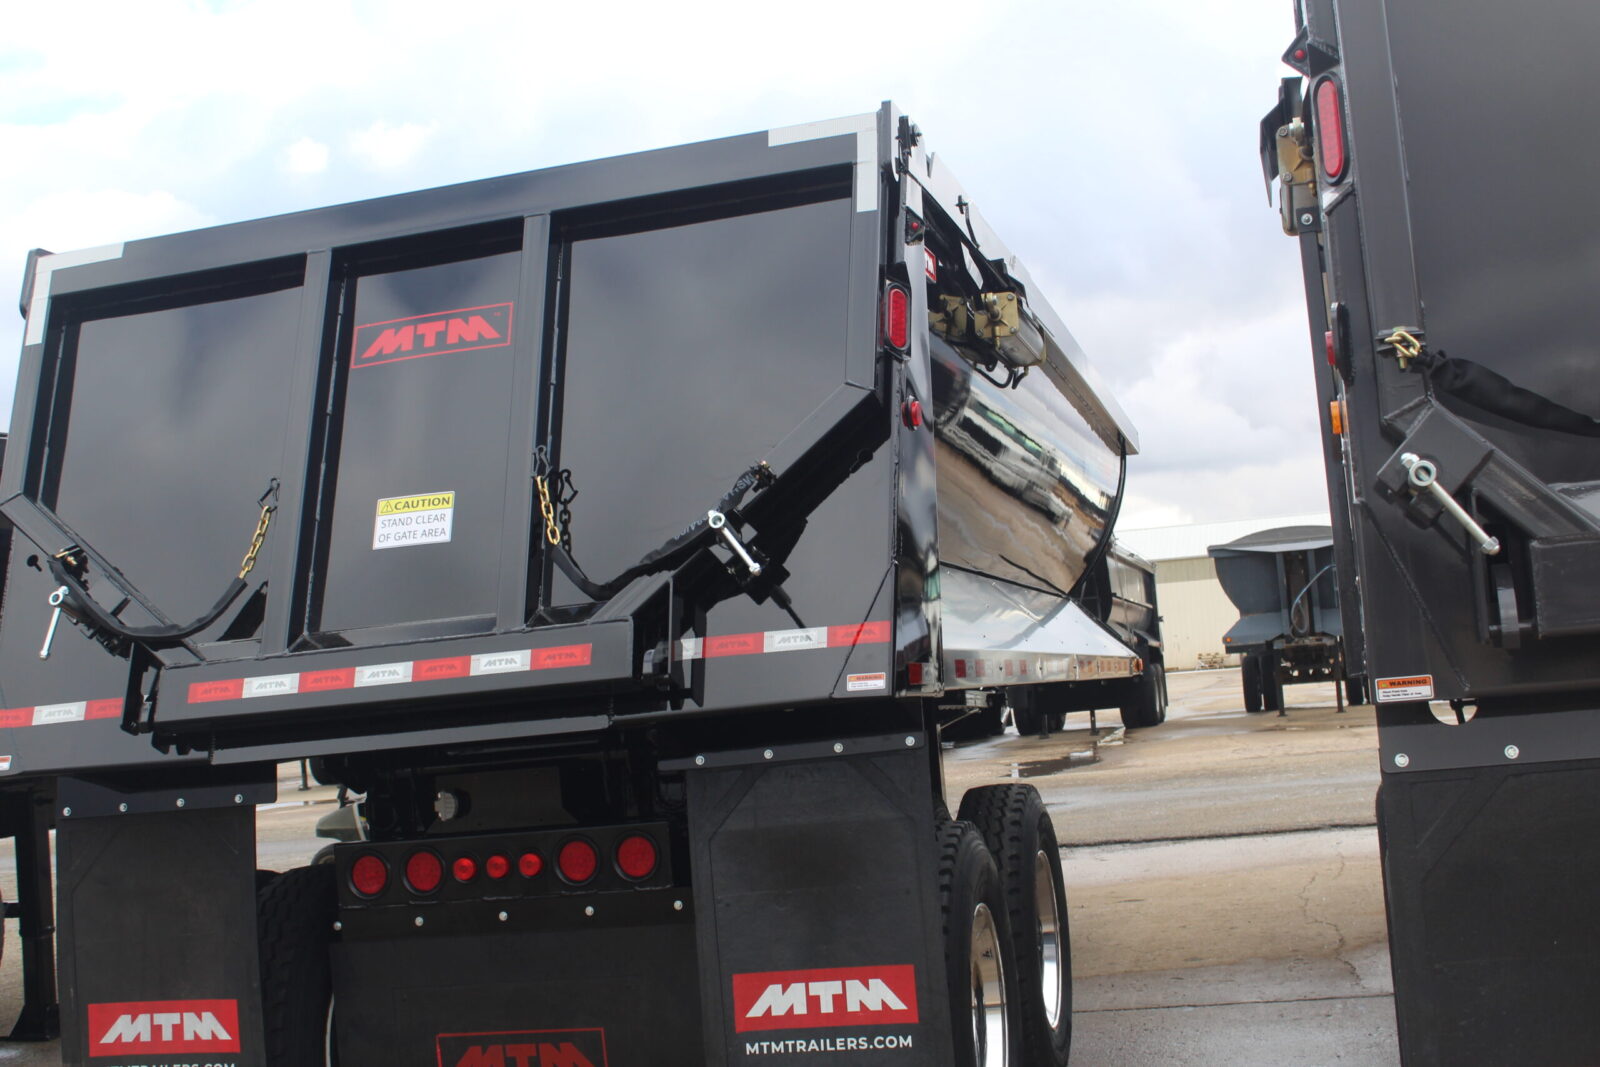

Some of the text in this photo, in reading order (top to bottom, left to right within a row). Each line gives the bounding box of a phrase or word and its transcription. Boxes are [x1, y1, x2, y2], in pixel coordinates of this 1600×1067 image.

[360, 315, 502, 359] MTM
[394, 496, 451, 511] CAUTION
[381, 513, 447, 529] STAND CLEAR
[378, 527, 447, 543] OF GATE AREA
[716, 628, 877, 650] MTM MTM MM
[200, 652, 578, 695] MTM MTM MTM MTM MTM MTM MTM
[1389, 678, 1428, 687] WARNING
[45, 708, 74, 718] MTM
[745, 979, 908, 1018] MTM
[99, 1011, 232, 1044] MTM
[455, 1042, 595, 1067] MTM
[745, 1035, 913, 1055] MTMTRAILERS.COM
